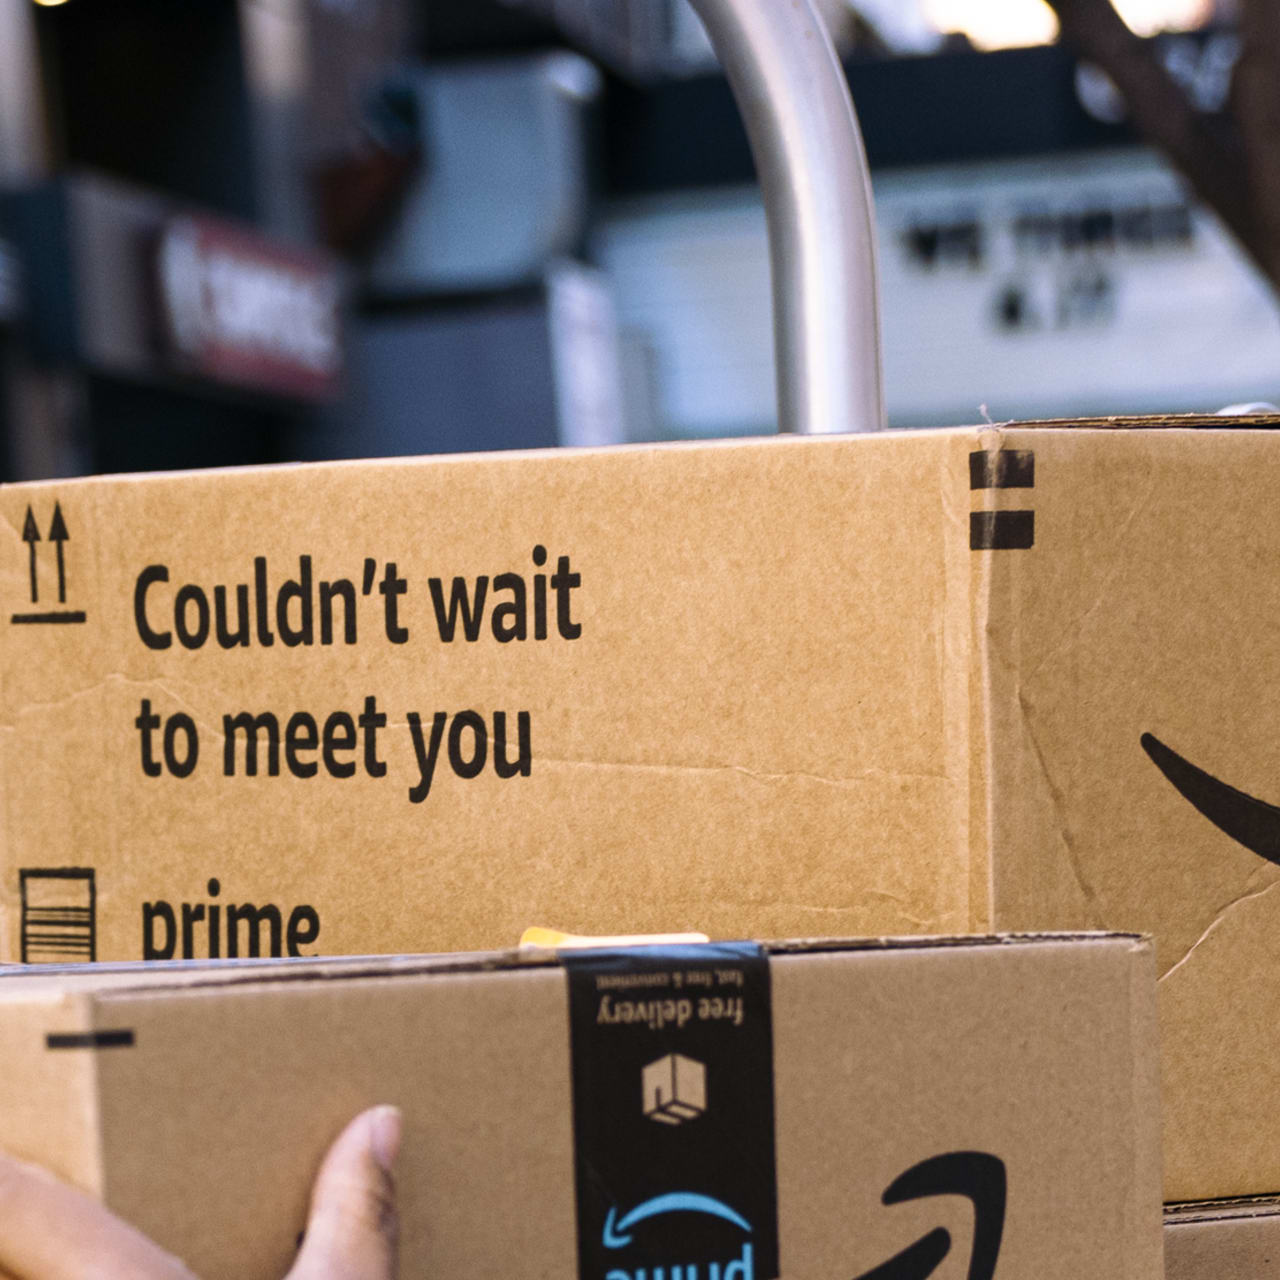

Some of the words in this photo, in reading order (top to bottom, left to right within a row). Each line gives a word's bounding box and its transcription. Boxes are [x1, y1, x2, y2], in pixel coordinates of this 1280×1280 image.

[133, 554, 409, 650] Couldn't
[428, 544, 582, 642] wait
[135, 697, 200, 778] to
[222, 694, 387, 779] meet
[407, 708, 533, 804] you
[141, 876, 322, 959] prime
[596, 993, 694, 1030] delivery
[697, 996, 744, 1027] free
